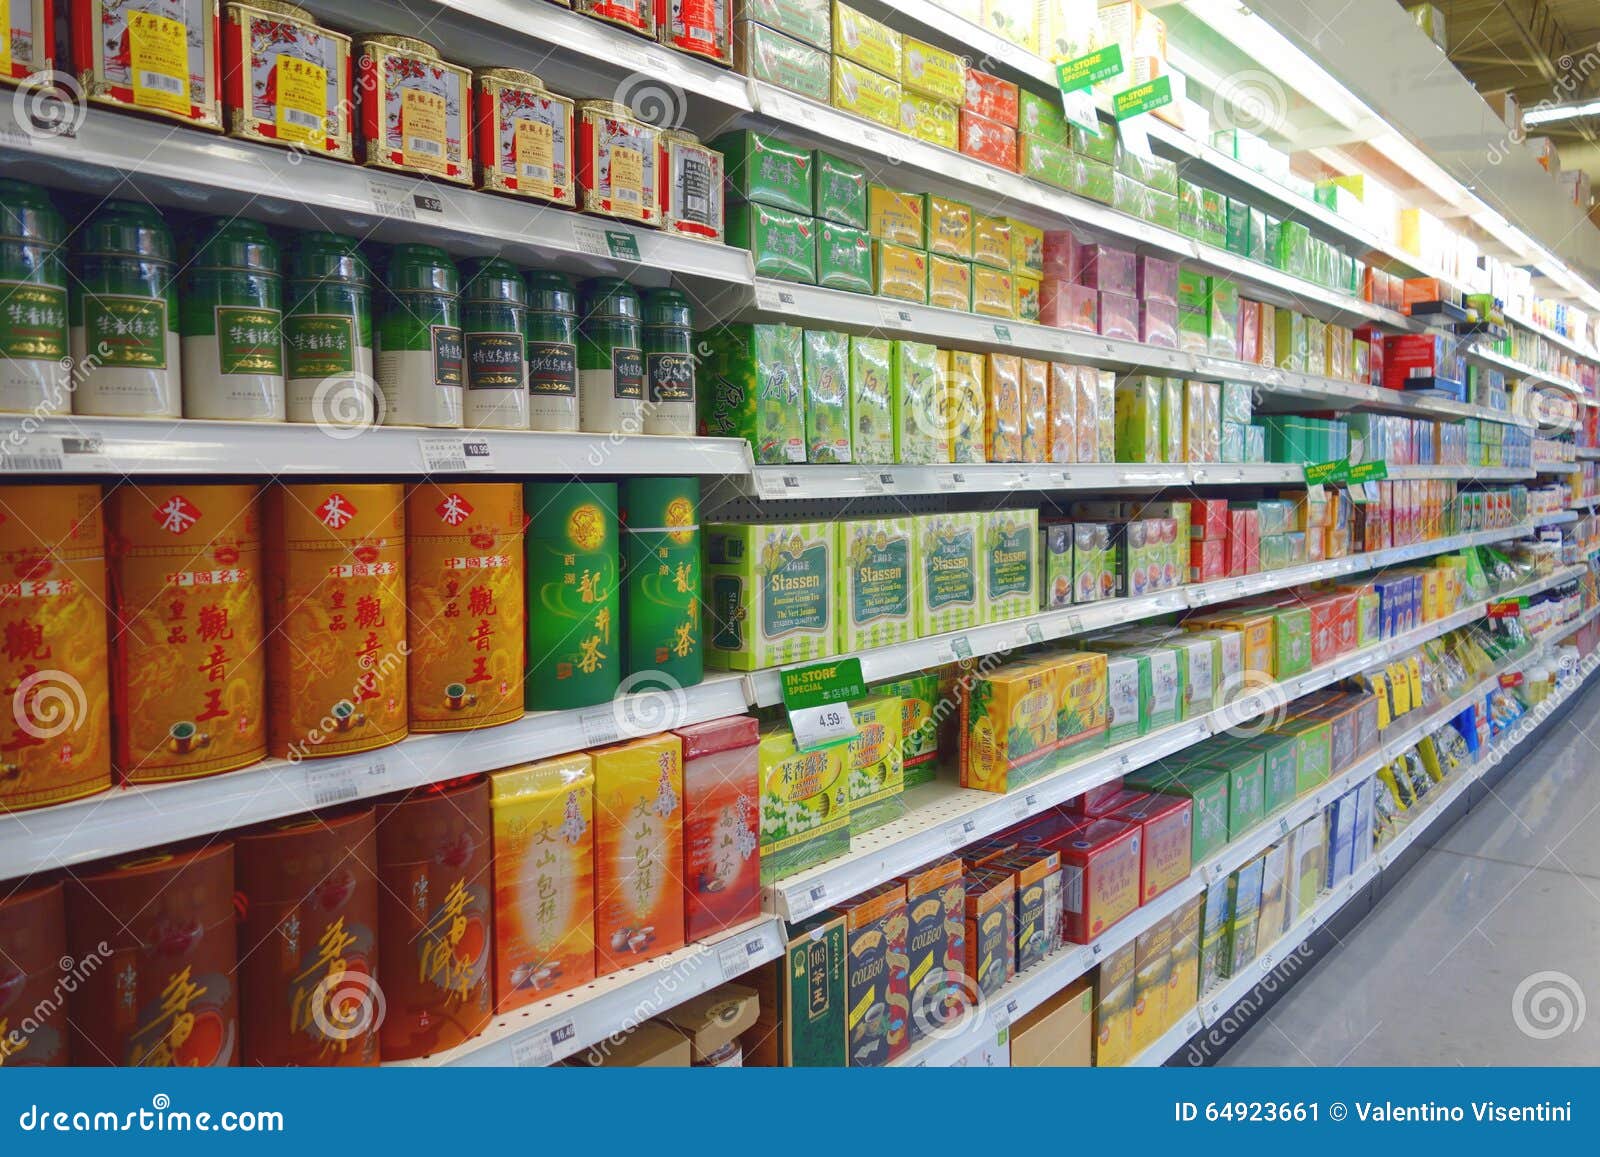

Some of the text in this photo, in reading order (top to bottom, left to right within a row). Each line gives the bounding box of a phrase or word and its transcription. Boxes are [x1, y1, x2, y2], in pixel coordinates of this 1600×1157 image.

[160, 496, 198, 533] 茶
[323, 495, 353, 530] 茶
[441, 494, 470, 525] 茶
[443, 554, 512, 570] 中國名茶
[932, 557, 969, 571] Stassen
[993, 550, 1027, 563] Stassen
[165, 567, 248, 586] 中國名茶
[328, 560, 398, 578] 中國名茶
[860, 567, 902, 583] Stassen
[771, 574, 820, 592] Stassen
[464, 584, 498, 684] 觀音王
[196, 603, 235, 723] 觀音王
[786, 667, 837, 685] IN-STORE
[788, 684, 823, 696] SPECIAL
[819, 711, 841, 727] 4.59
[911, 925, 942, 951] COLEGO
[810, 946, 825, 968] 103
[851, 957, 885, 988] COLEGO
